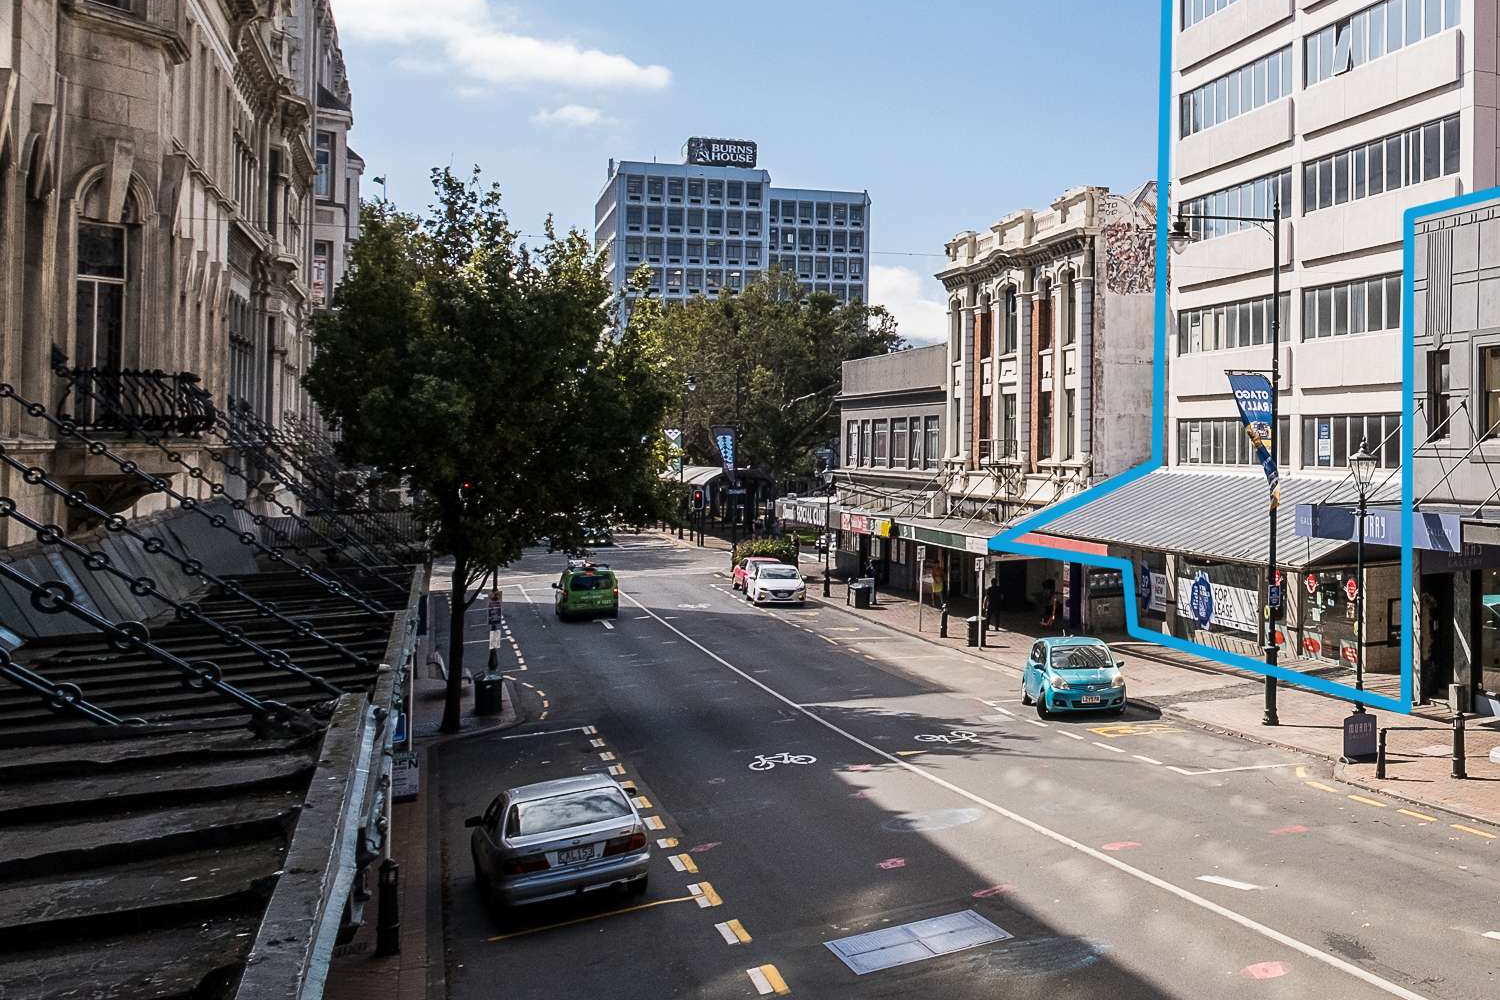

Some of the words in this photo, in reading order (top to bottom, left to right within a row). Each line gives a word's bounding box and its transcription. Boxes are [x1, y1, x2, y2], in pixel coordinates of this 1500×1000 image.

[711, 143, 753, 154] BURNS
[711, 153, 753, 163] HOUSE
[796, 506, 812, 524] SOCIAL
[813, 508, 826, 526] CLUB
[1214, 587, 1228, 602] FOR
[1214, 602, 1233, 618] LEASE
